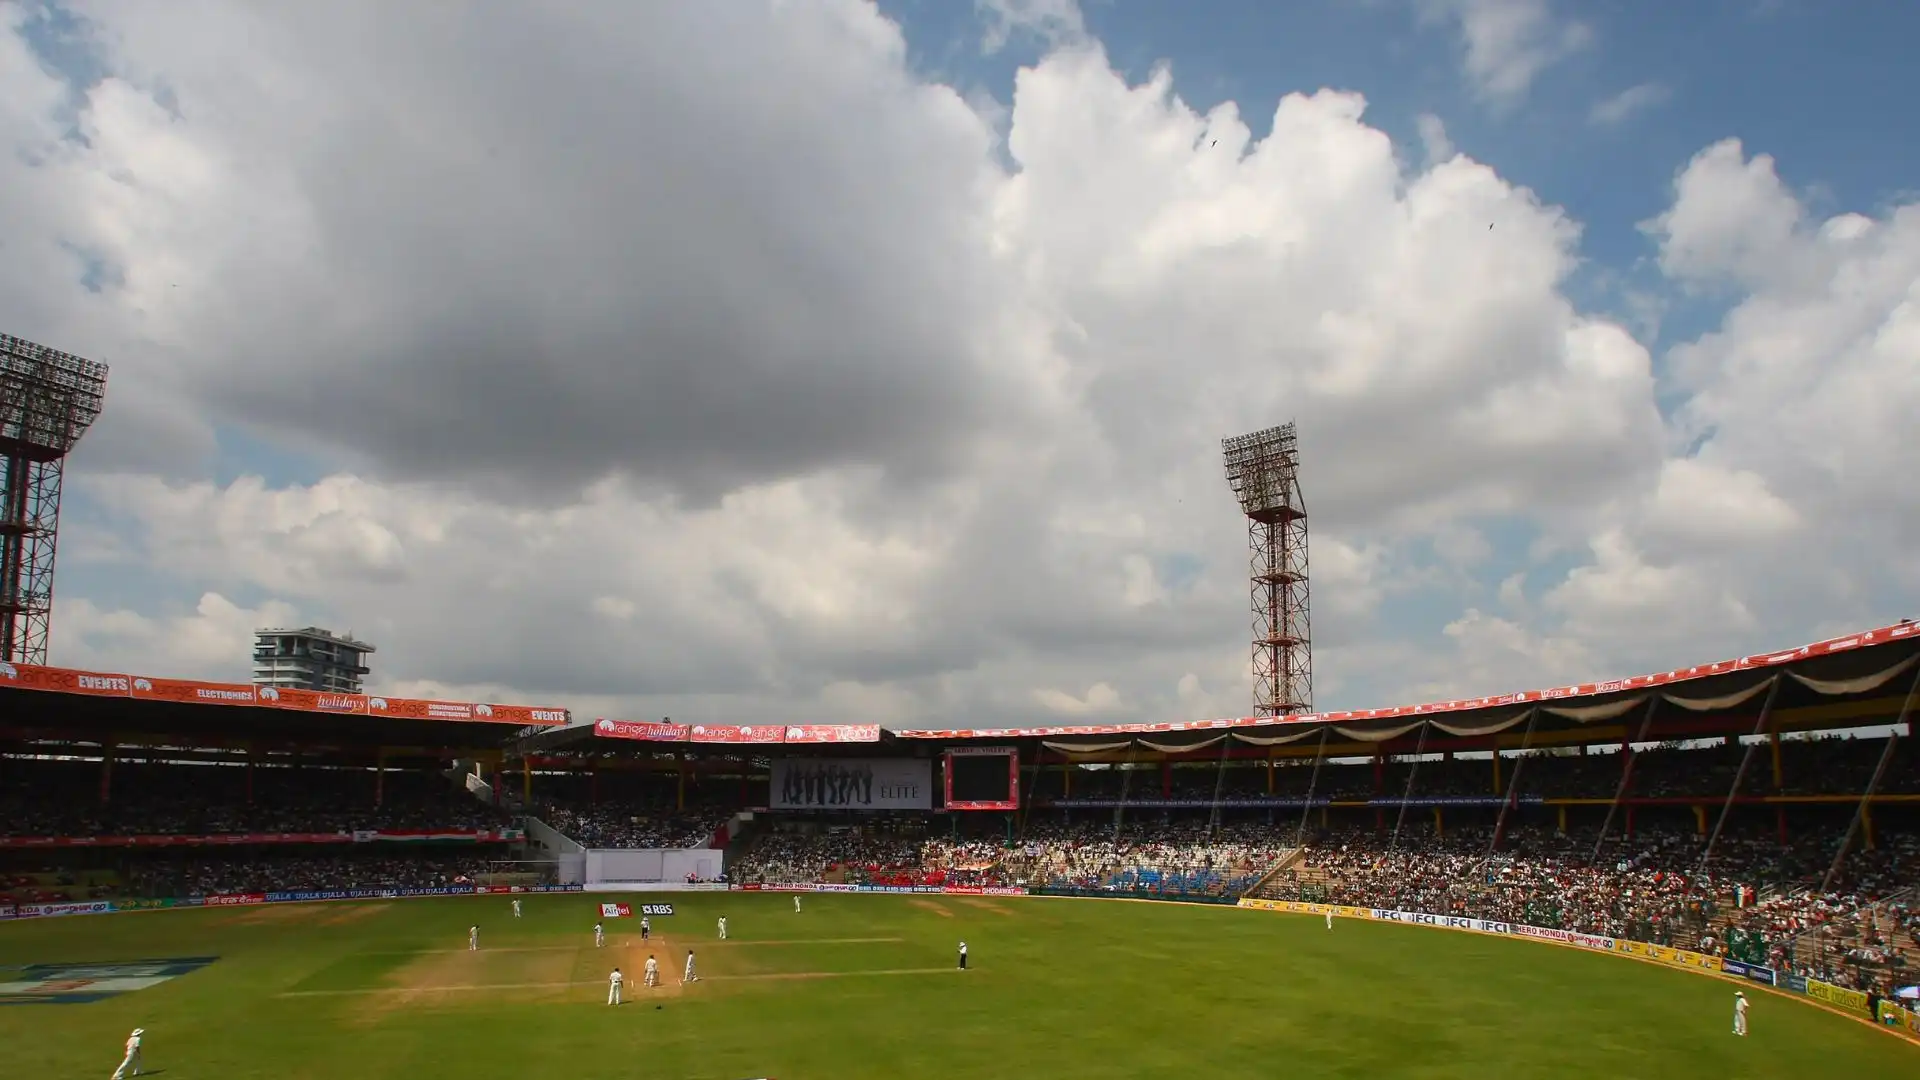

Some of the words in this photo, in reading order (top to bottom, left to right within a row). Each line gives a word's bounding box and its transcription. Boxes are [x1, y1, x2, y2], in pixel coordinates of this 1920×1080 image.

[78, 675, 128, 690] EVENTS
[197, 688, 253, 701] ELECTRONICS
[317, 694, 365, 712] holidays
[531, 710, 565, 721] EVENTS
[646, 725, 687, 738] holidays
[880, 785, 920, 799] ELITE
[266, 893, 291, 901] UJALA
[322, 891, 346, 900] UJALA
[350, 890, 373, 898] UJALA
[402, 888, 424, 896] UJALA
[426, 888, 448, 896] UJALA
[452, 886, 473, 894] UJALA
[982, 887, 1014, 895] GHODAWAT
[93, 903, 106, 911] GO
[653, 904, 673, 914] RBS
[1412, 913, 1436, 924] IFCI
[1446, 917, 1470, 928] IFCI
[1482, 921, 1508, 933] IFCI
[1518, 926, 1537, 936] HERO
[1539, 929, 1566, 939] HONDA
[1603, 939, 1613, 949] GO
